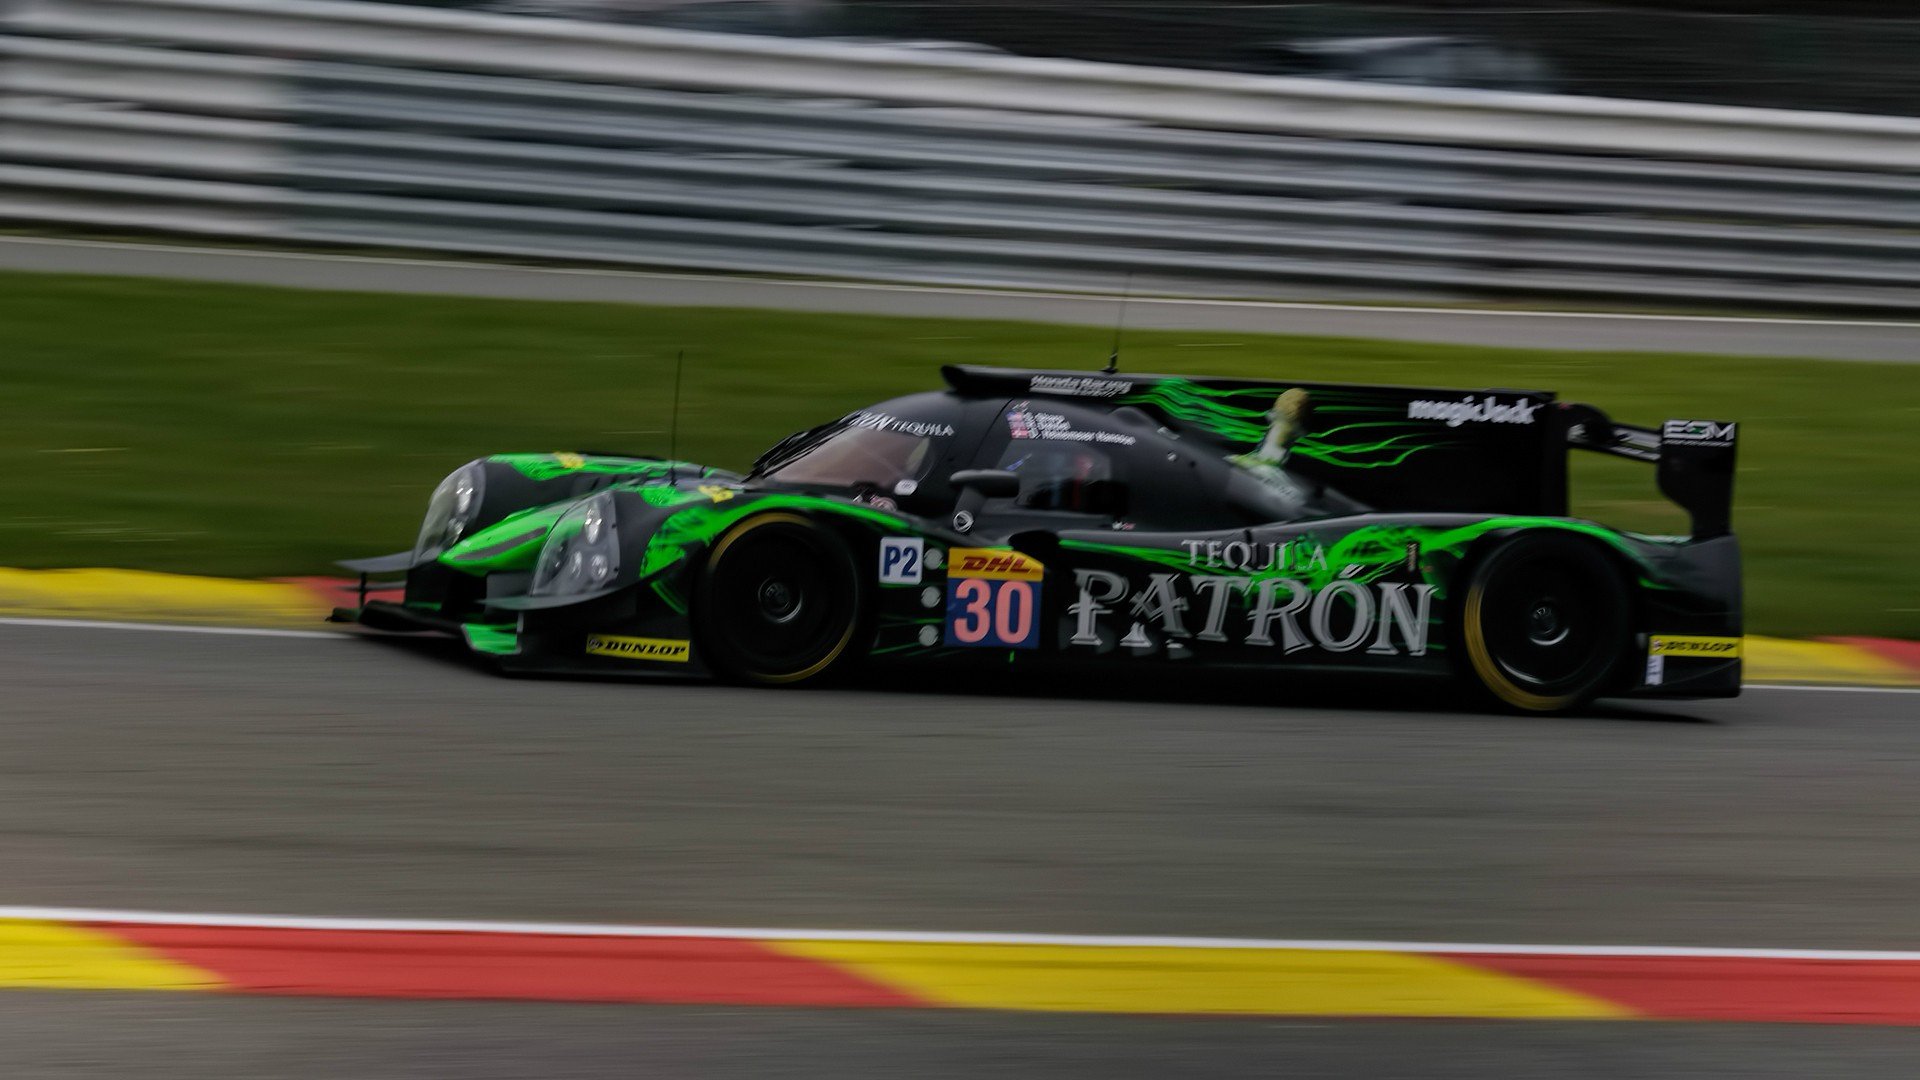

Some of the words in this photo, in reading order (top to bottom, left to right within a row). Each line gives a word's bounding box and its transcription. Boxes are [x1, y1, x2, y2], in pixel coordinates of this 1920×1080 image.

[1408, 395, 1536, 428] magicJack
[883, 546, 919, 577] P2
[962, 556, 1030, 573] DHL
[1181, 539, 1327, 572] TEQUILA
[954, 578, 1033, 644] 30
[1066, 564, 1439, 657] PATRÓN
[605, 641, 686, 655] DUNLOP
